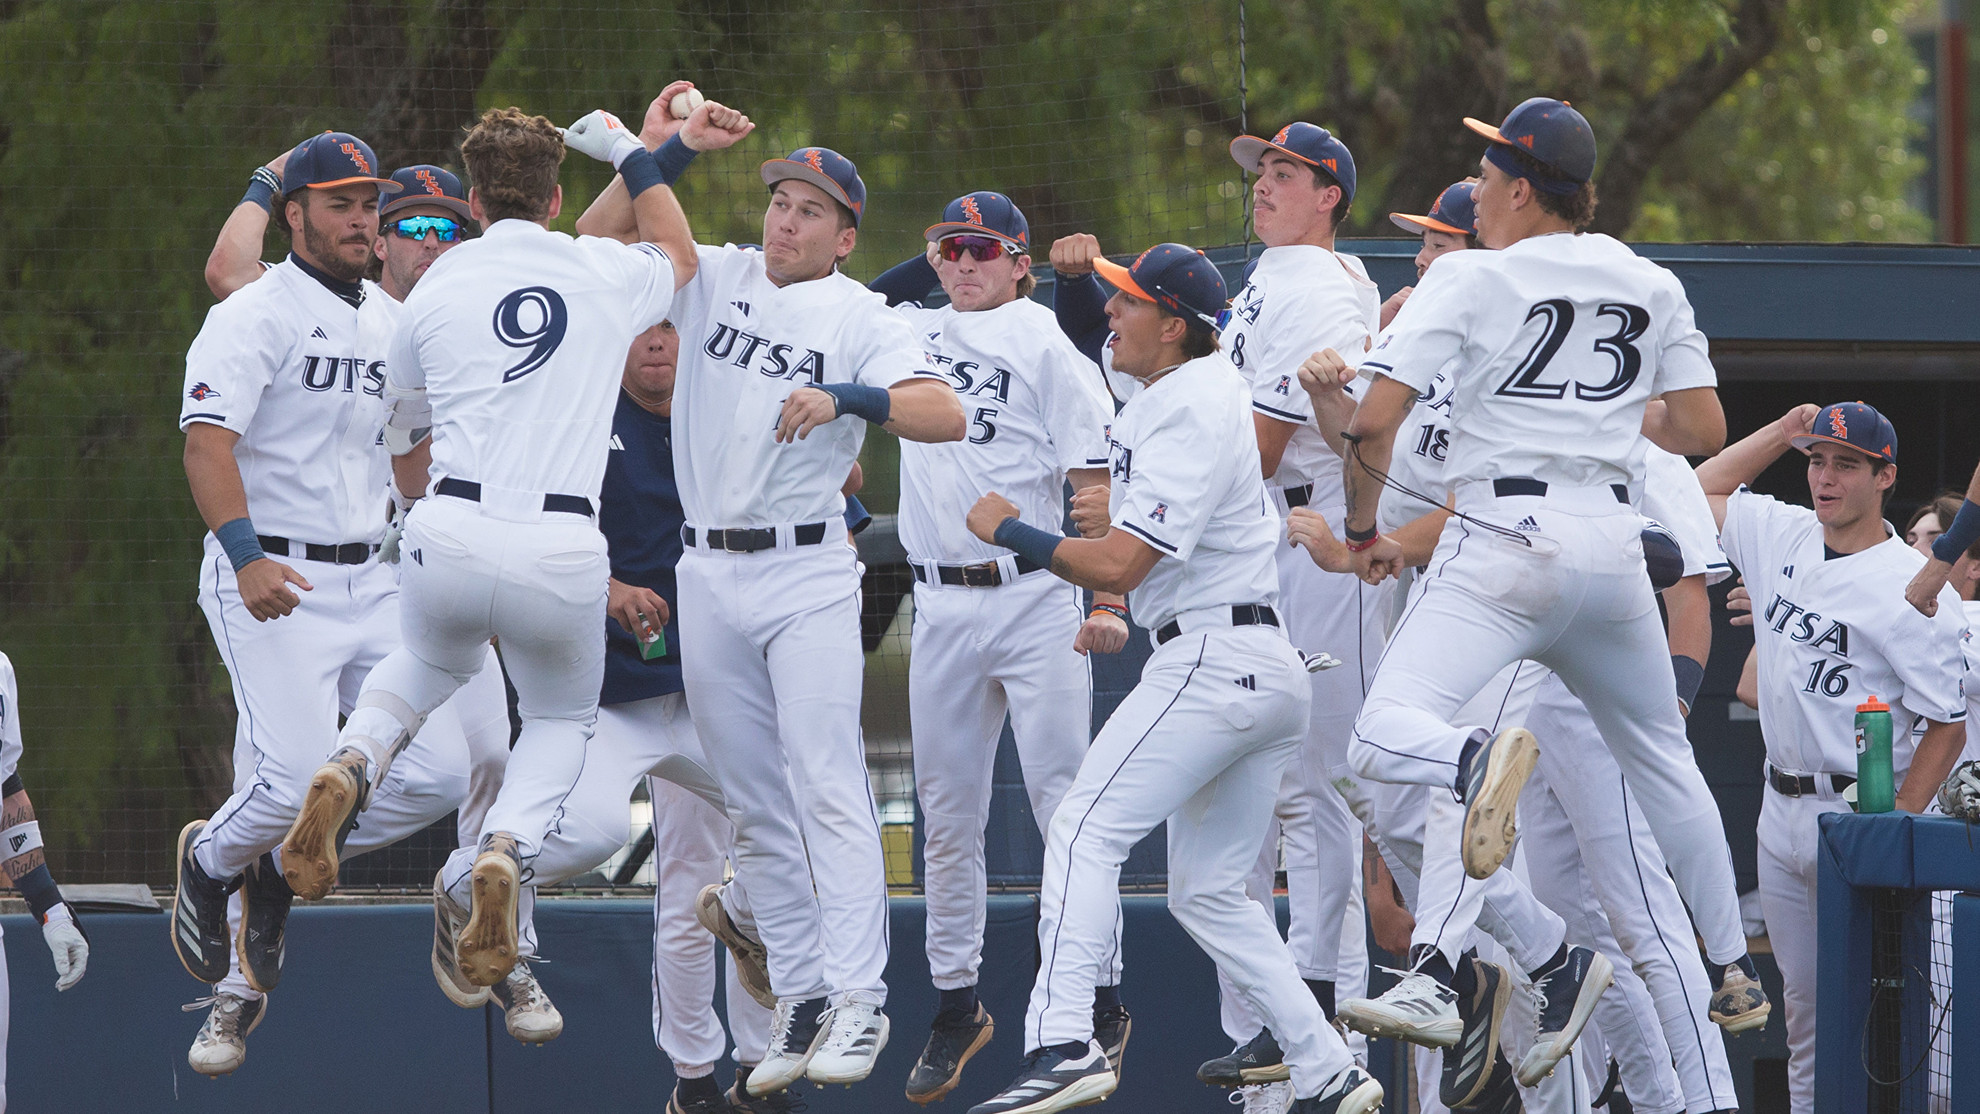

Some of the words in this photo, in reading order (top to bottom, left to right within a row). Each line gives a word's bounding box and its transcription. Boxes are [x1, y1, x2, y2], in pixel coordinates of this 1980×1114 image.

[492, 285, 568, 384] 9
[703, 321, 825, 386] UTSA
[1230, 332, 1245, 370] 8
[1494, 298, 1651, 402] 23
[968, 407, 999, 445] 5
[1413, 423, 1450, 462] 18
[1514, 523, 1541, 533] adidas
[1802, 658, 1853, 697] 16
